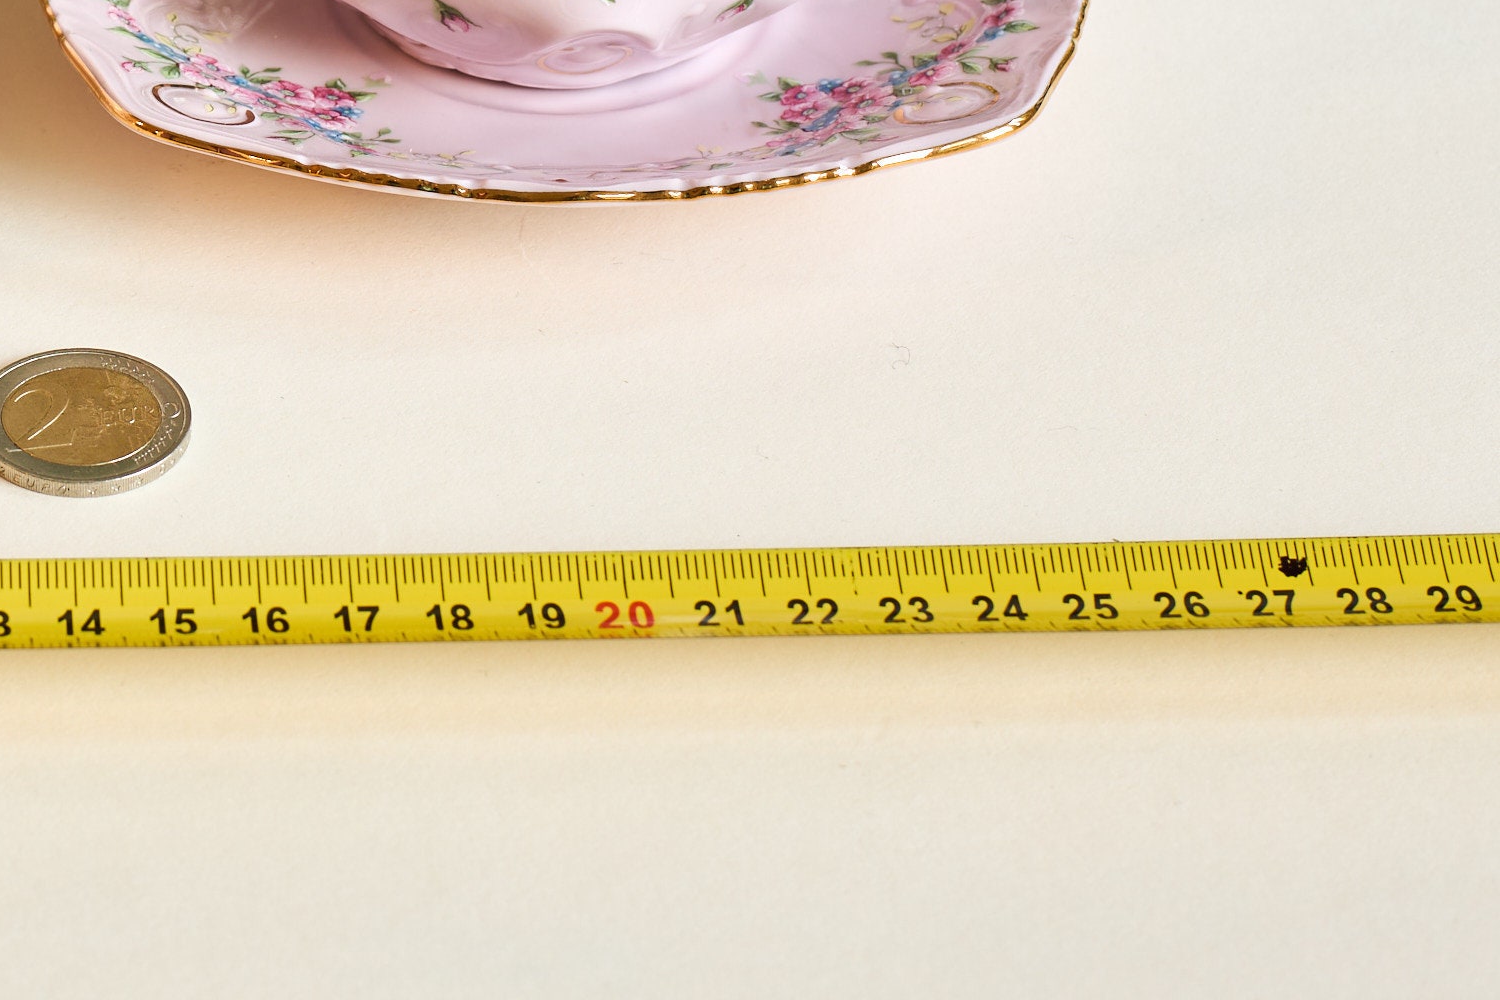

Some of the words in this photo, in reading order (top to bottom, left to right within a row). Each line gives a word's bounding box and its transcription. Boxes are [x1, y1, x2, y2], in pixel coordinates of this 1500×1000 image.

[6, 383, 78, 453] 2
[99, 402, 181, 428] EURO
[57, 609, 106, 636] 14
[149, 608, 198, 635] 15
[242, 606, 290, 634] 16
[334, 605, 380, 633] 17
[426, 603, 475, 631] 18
[518, 602, 566, 629] 19
[595, 600, 655, 629] 20
[694, 599, 745, 627] 21
[787, 597, 839, 625] 22
[879, 596, 935, 624] 23
[971, 594, 1029, 622] 24
[1062, 593, 1119, 621] 25
[1153, 591, 1211, 619] 26
[1245, 589, 1296, 617] 27
[1336, 587, 1394, 615] 28
[1426, 584, 1483, 613] 29
